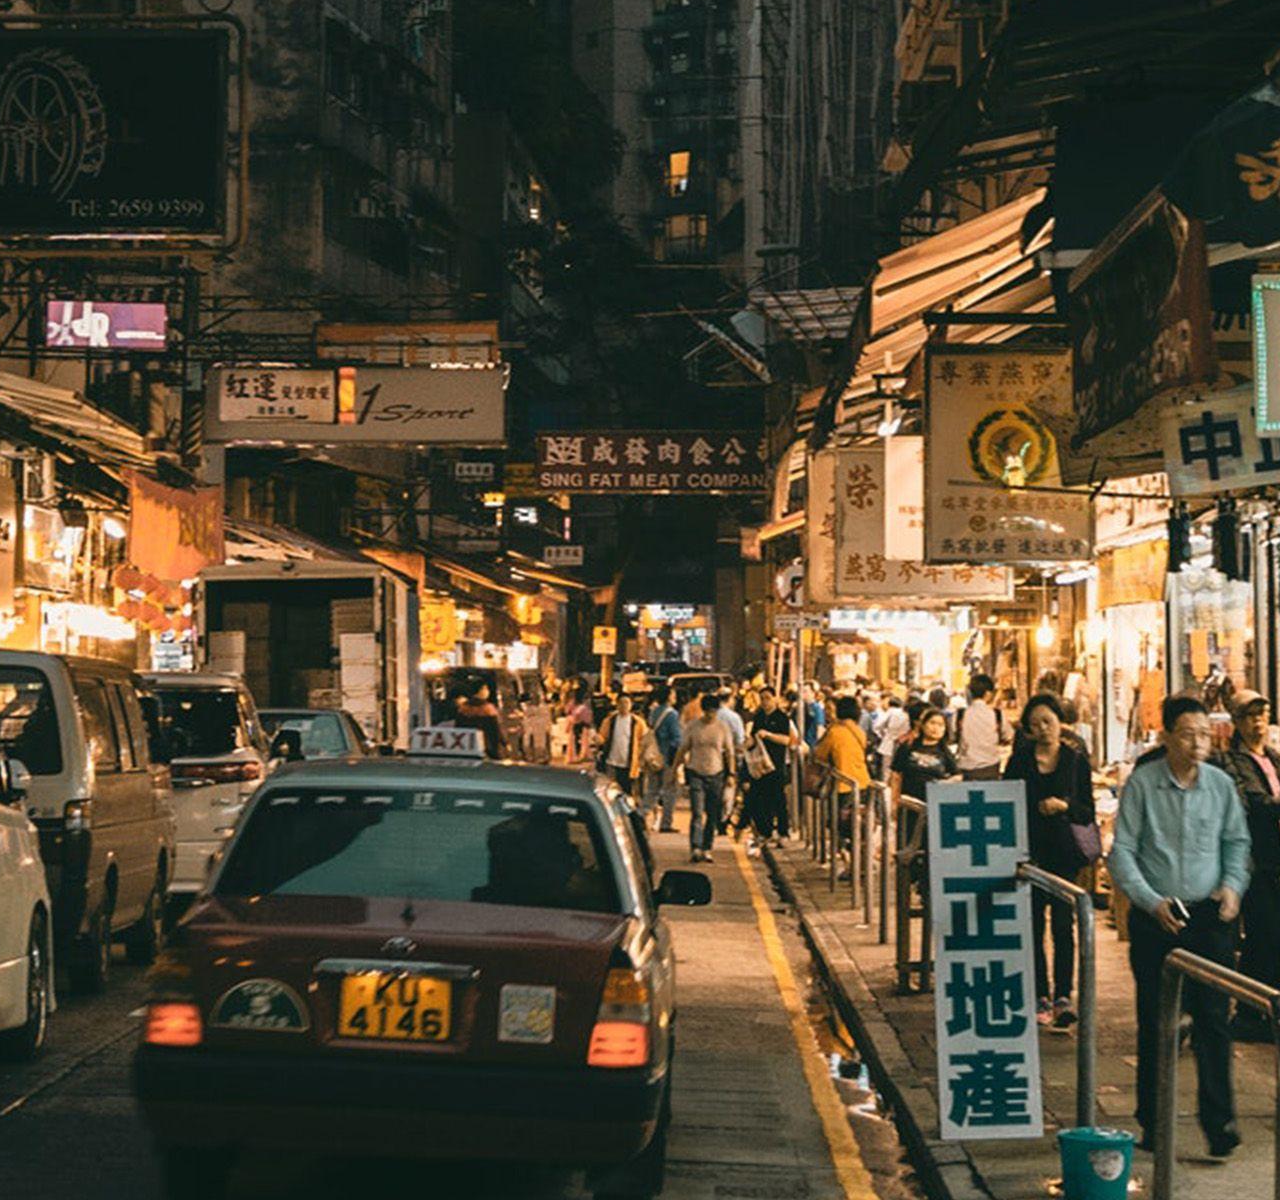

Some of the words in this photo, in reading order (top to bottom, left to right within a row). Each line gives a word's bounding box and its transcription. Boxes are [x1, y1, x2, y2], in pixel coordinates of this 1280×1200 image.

[68, 199, 101, 217] Tel:
[540, 472, 584, 488] SING
[588, 472, 622, 488] FAT
[629, 472, 681, 488] MEAT
[687, 472, 770, 488] COMPAN
[418, 731, 476, 751] TAXI
[939, 789, 1032, 1127] 中正地產
[349, 1005, 442, 1037] 4146
